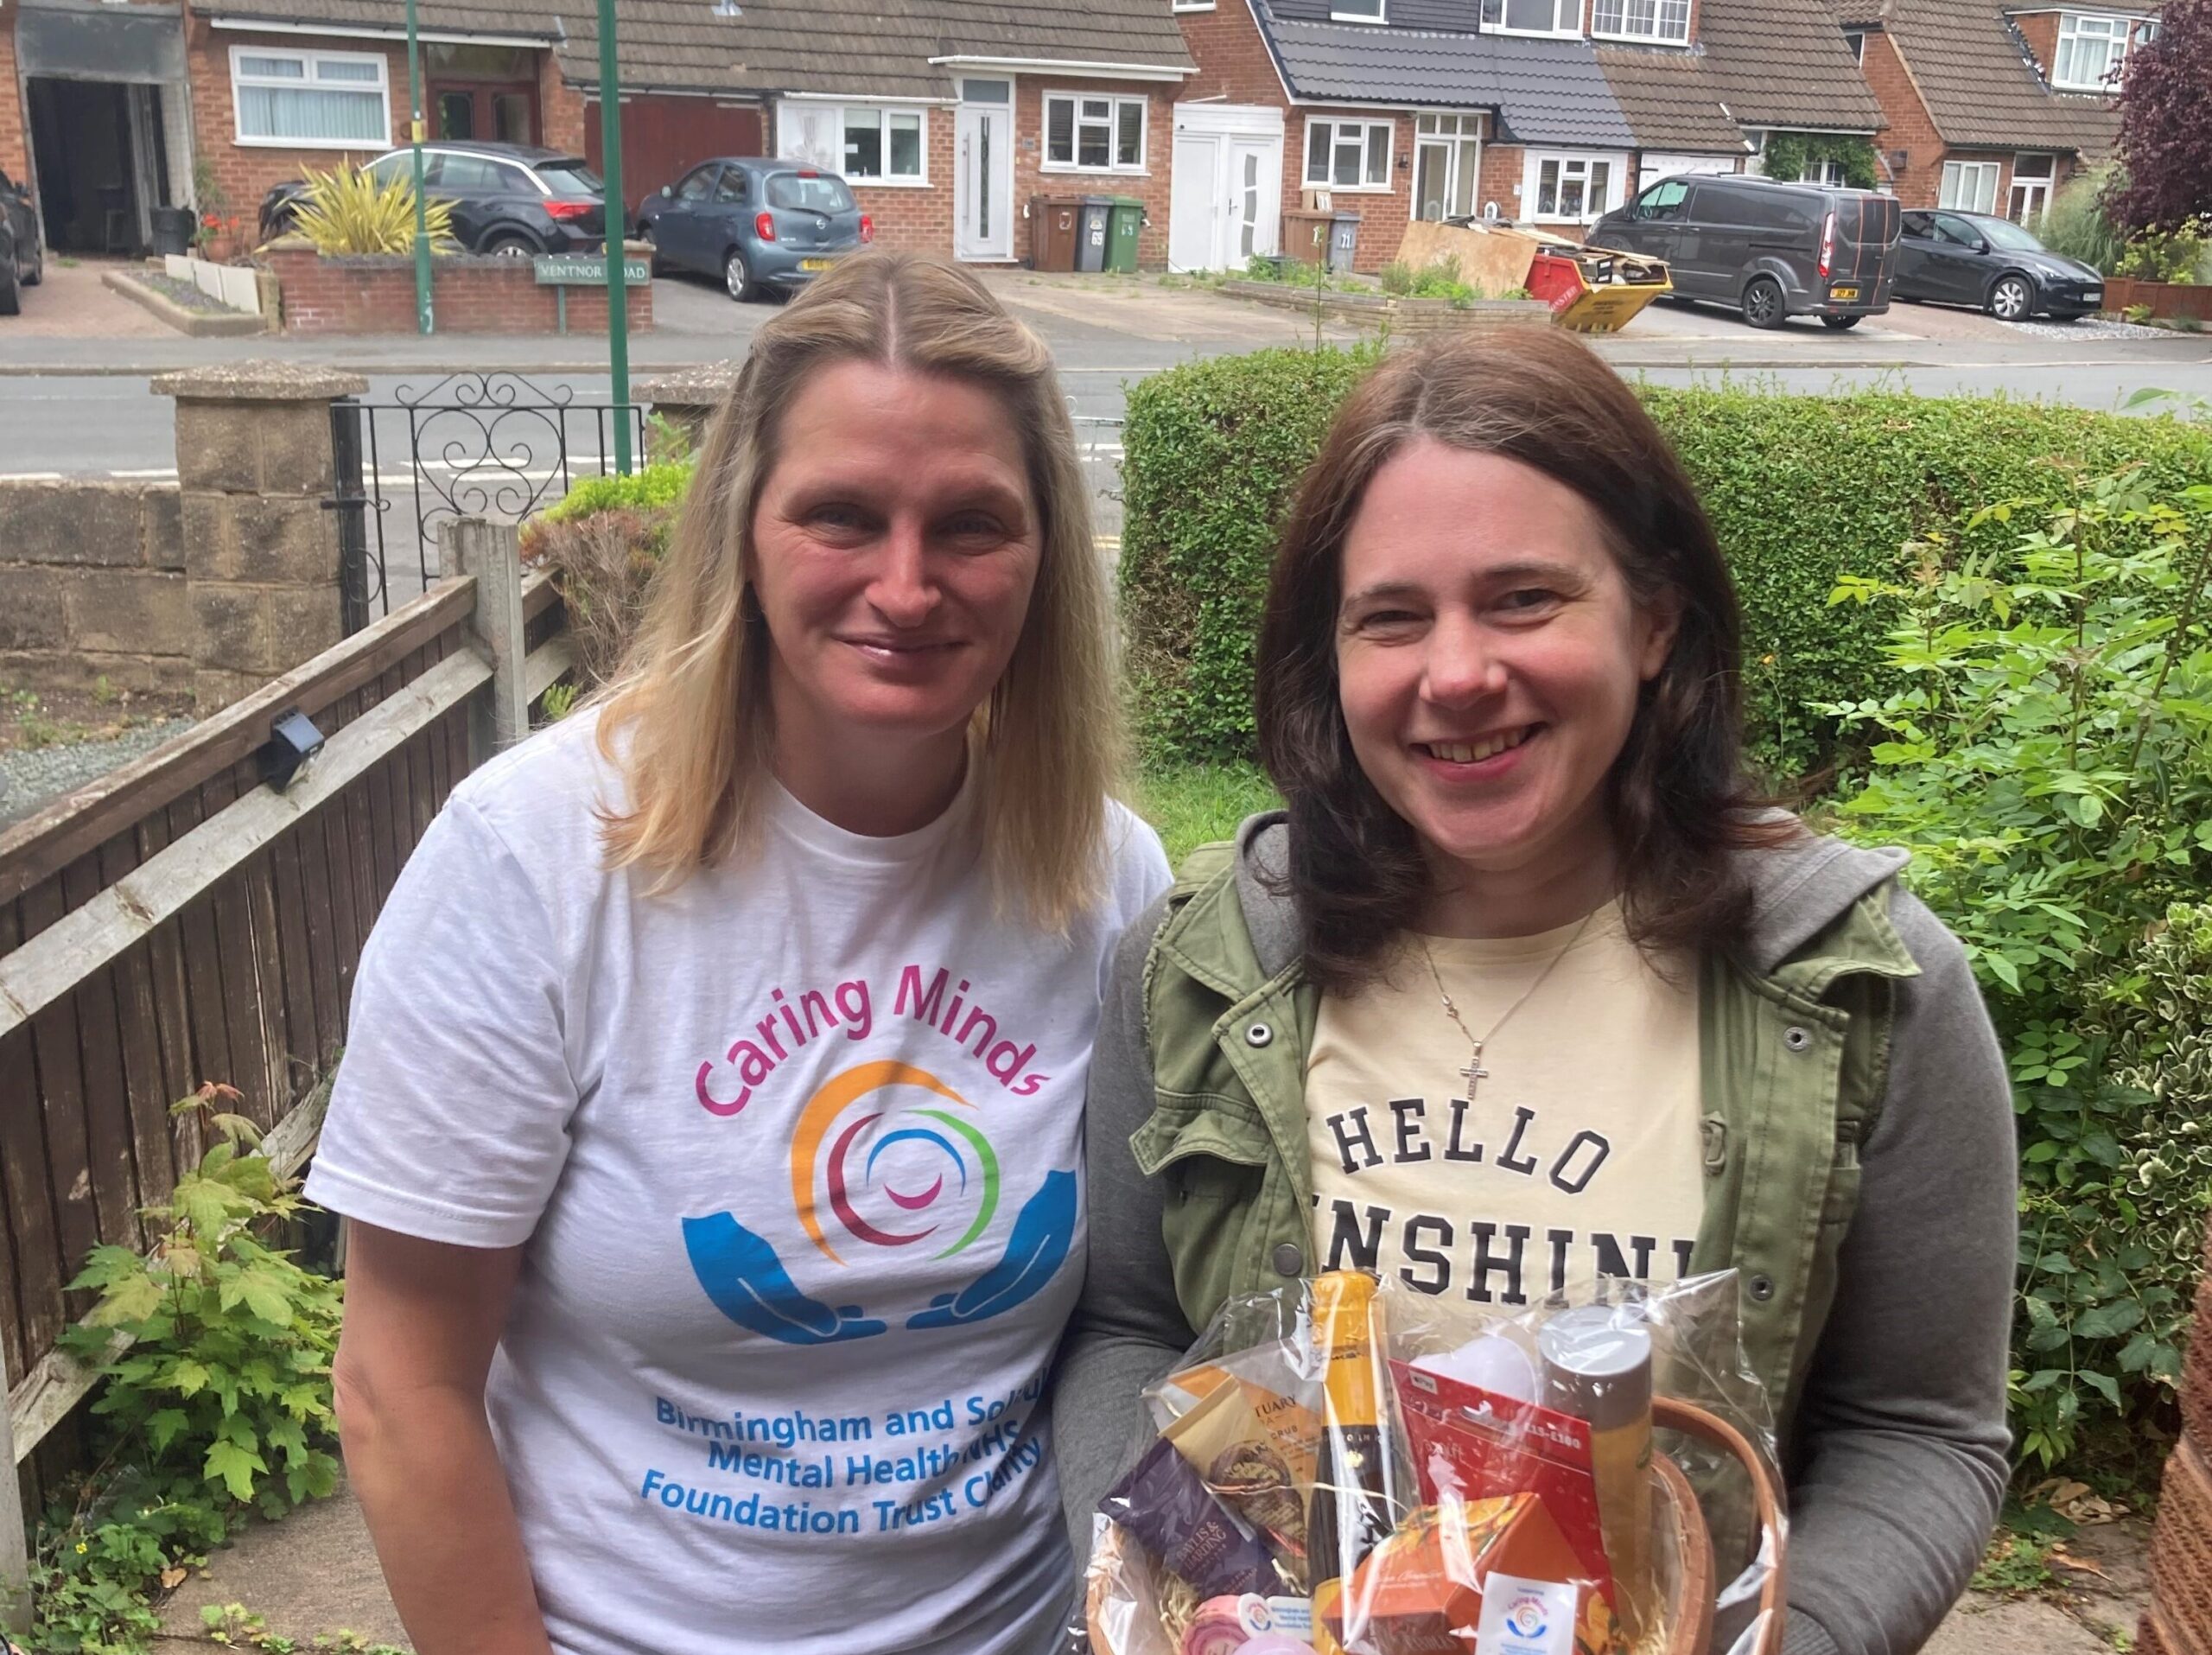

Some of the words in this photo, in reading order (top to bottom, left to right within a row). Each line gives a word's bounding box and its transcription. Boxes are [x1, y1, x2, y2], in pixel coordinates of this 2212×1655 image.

[1091, 232, 1103, 245] 69
[542, 264, 602, 278] VENTNOR
[623, 266, 645, 279] AD
[695, 979, 872, 1117] Caring
[893, 964, 1052, 1097] Minds
[1325, 1098, 1611, 1194] HELLO
[1312, 1194, 1696, 1308] NSHIN
[655, 1396, 873, 1448] Birmingham
[886, 1399, 954, 1436] and
[1255, 1395, 1296, 1417] TUARY
[1270, 1424, 1299, 1440] CRUB
[708, 1440, 833, 1488] Mental
[845, 1443, 959, 1486] Health
[639, 1468, 860, 1534] Foundation
[873, 1488, 957, 1532] Trust
[1205, 1521, 1219, 1533] &
[1184, 1529, 1227, 1571] HARDING
